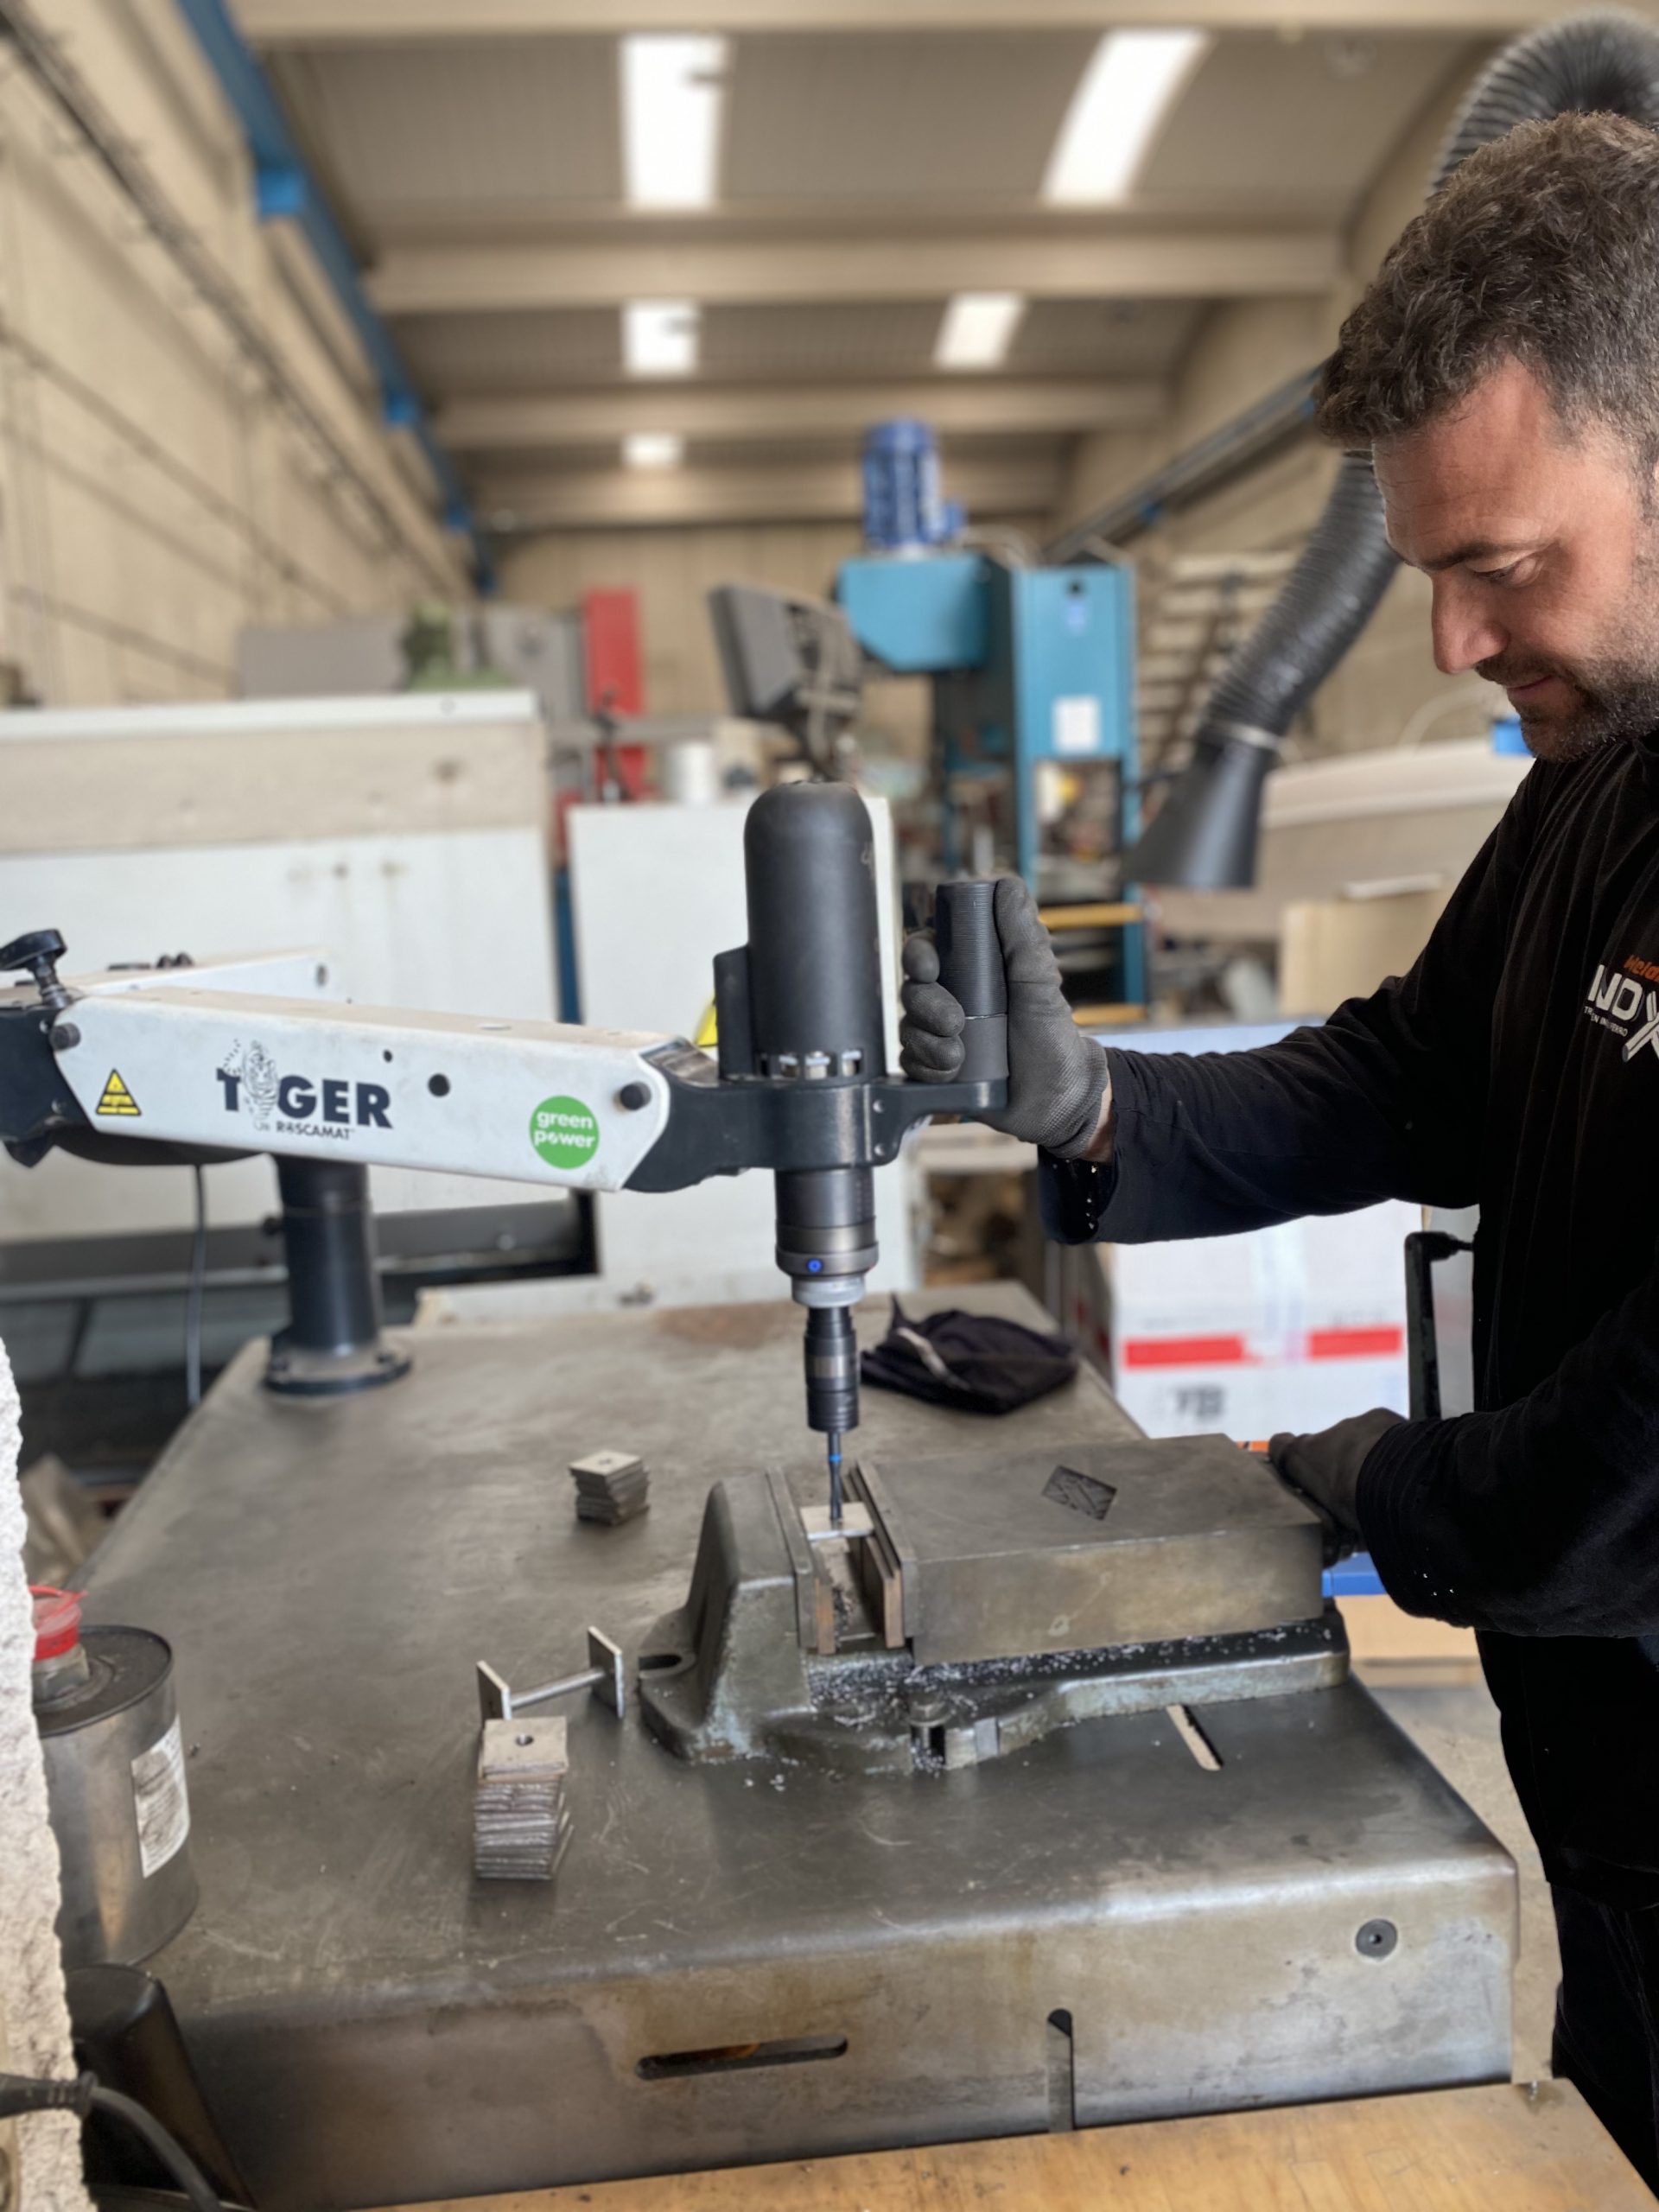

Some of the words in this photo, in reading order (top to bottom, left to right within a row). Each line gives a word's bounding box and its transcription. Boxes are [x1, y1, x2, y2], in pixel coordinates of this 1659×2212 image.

[216, 1067, 393, 1129] TGER
[537, 1111, 594, 1130] green
[534, 1128, 595, 1148] power
